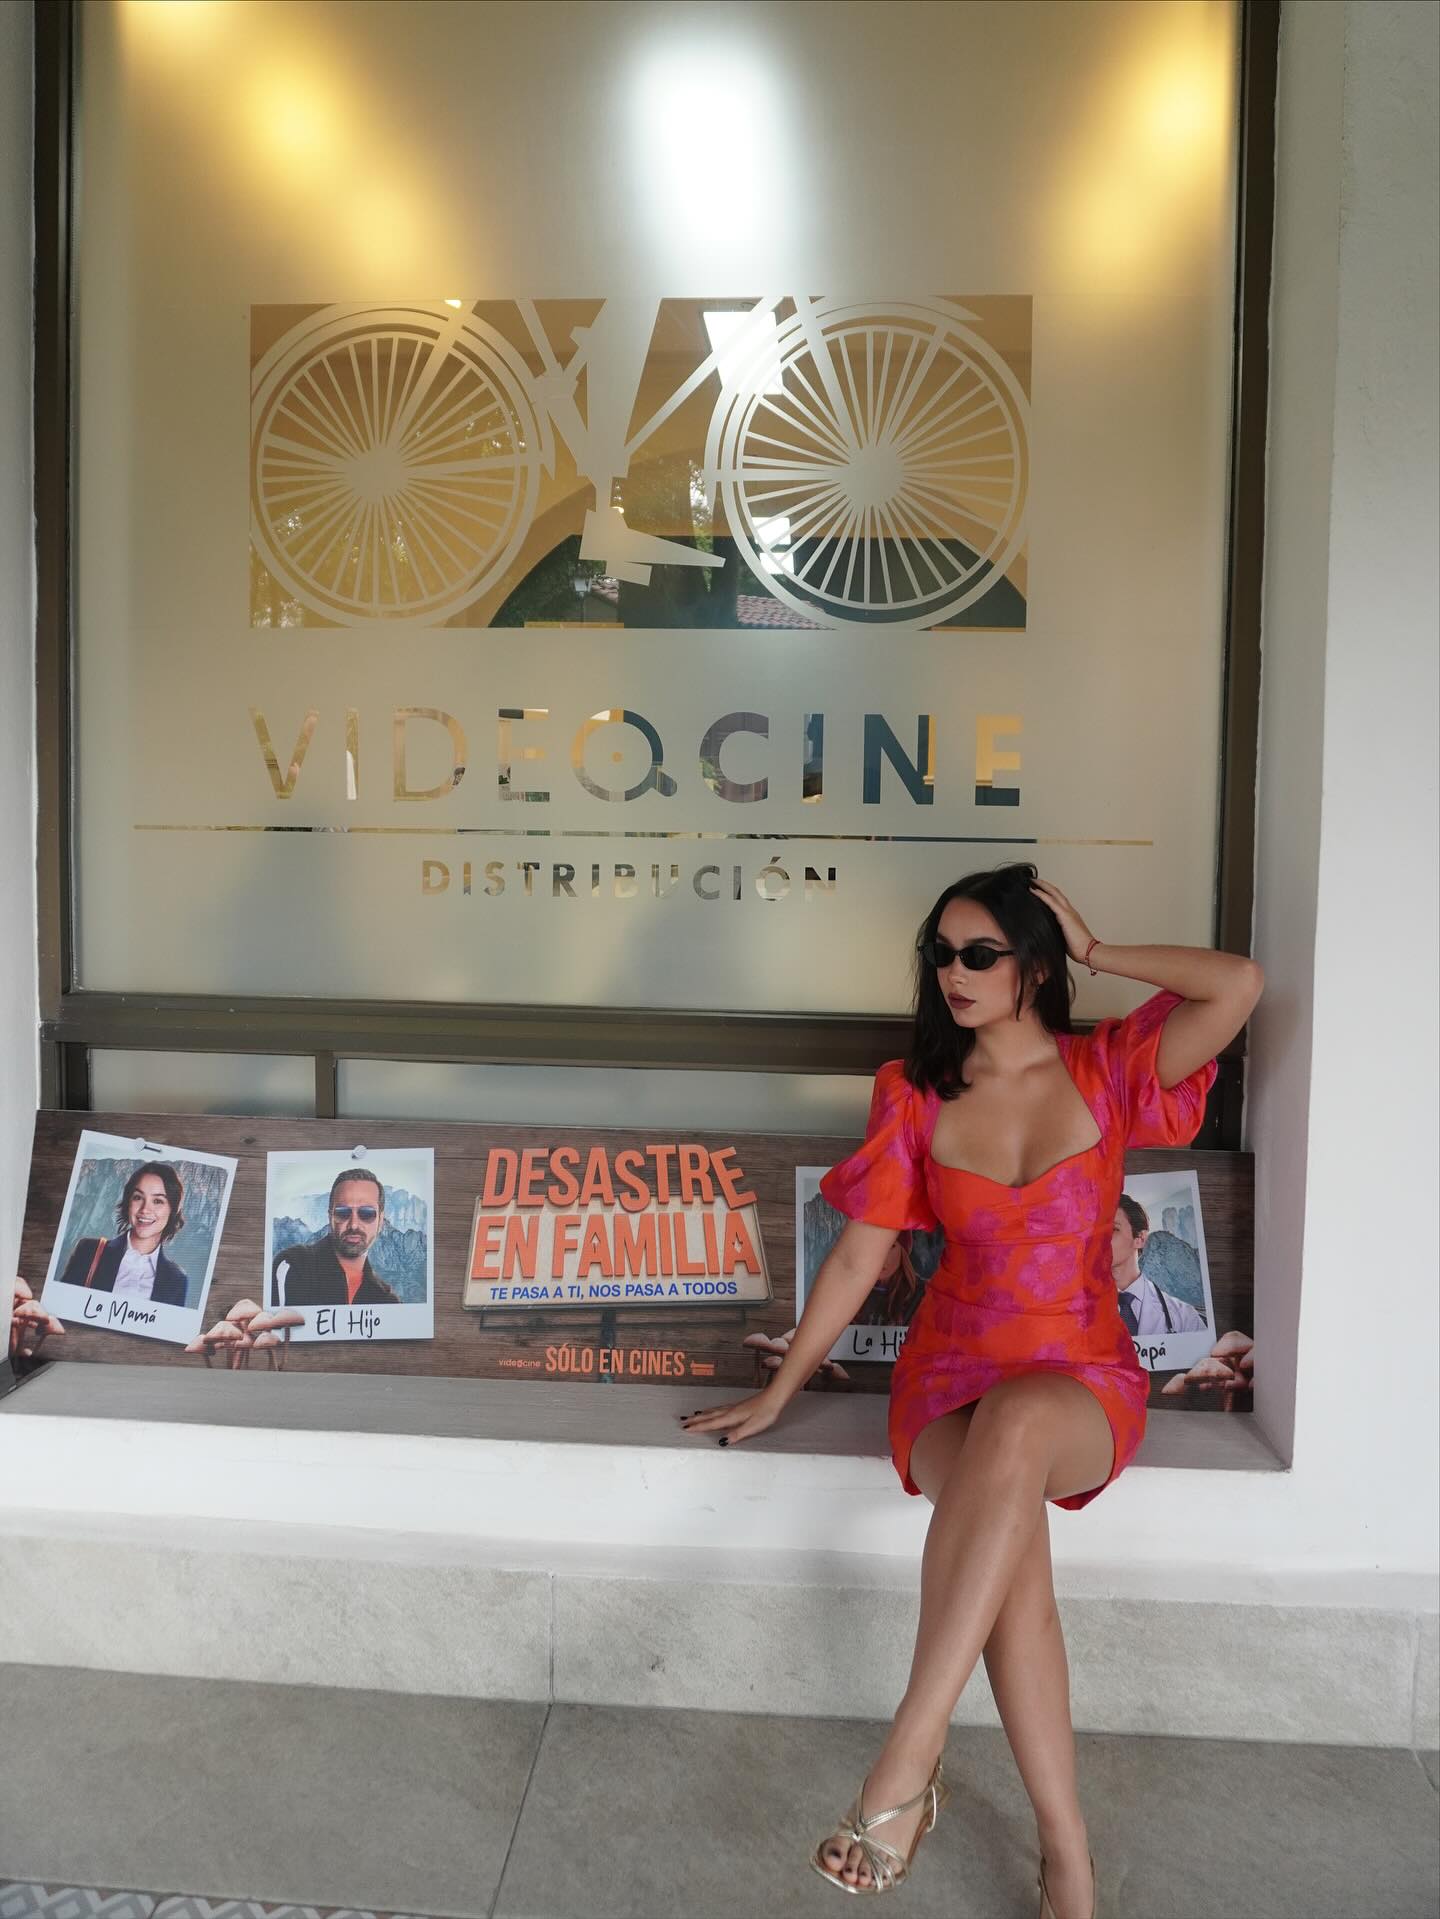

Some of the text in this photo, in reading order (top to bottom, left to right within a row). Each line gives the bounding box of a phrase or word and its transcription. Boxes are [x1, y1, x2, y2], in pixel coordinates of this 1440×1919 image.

[248, 707, 1023, 806] VIDEOCINE
[422, 856, 839, 901] DISTRIBUCIÓN
[481, 1144, 757, 1213] DESASTRE
[471, 1212, 761, 1280] EN FAMILIA
[490, 1281, 738, 1300] TE PASA A TI, NOS PASA A TODOS
[83, 1294, 157, 1325] La Mamá
[316, 1309, 381, 1339] El Hijo
[545, 1343, 594, 1373] SÓLO
[599, 1349, 624, 1374] EN
[629, 1349, 686, 1376] CINES
[853, 1329, 907, 1358] La Hi
